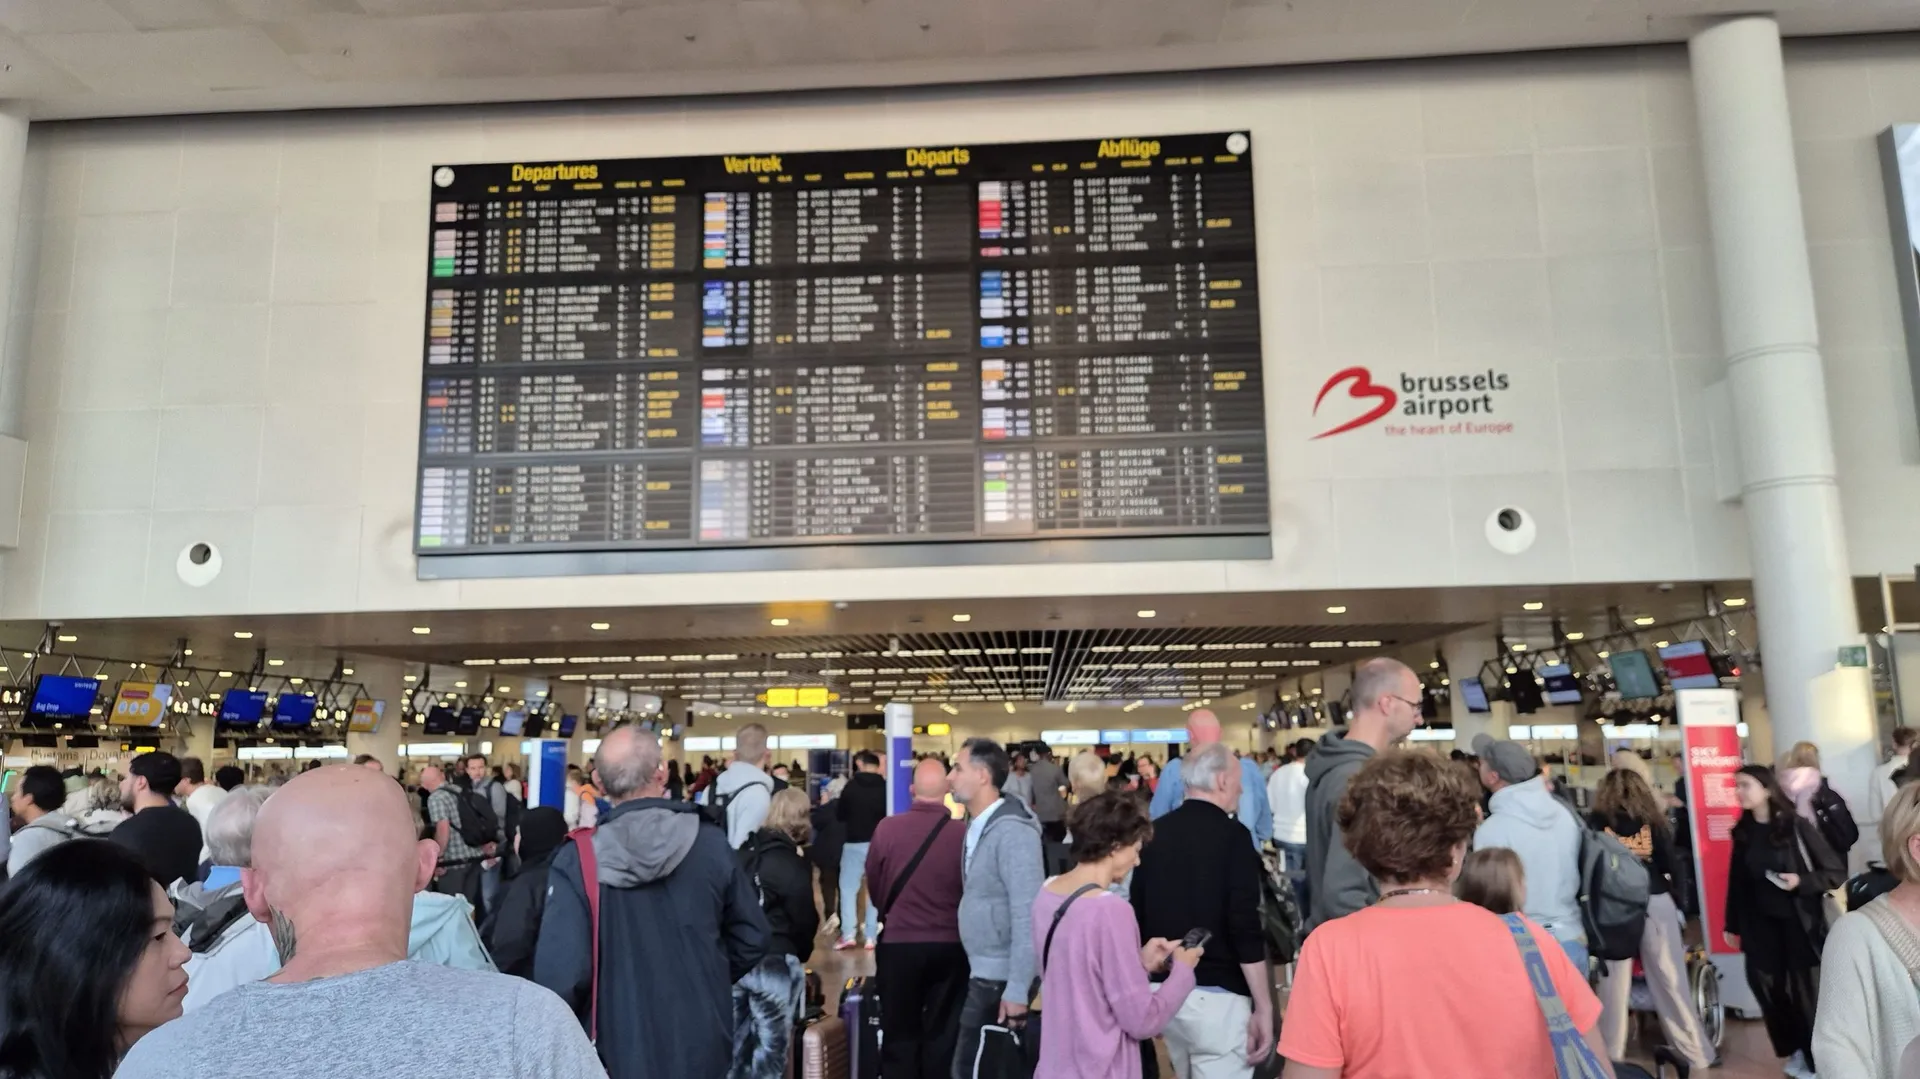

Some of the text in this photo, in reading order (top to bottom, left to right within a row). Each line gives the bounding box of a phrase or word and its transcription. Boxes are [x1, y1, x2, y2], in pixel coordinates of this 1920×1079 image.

[906, 147, 970, 169] Départs
[1098, 140, 1161, 159] Abflüge
[512, 164, 598, 183] Departures
[724, 154, 783, 174] Vertrek
[1401, 369, 1509, 393] brussels
[1403, 394, 1493, 419] airport
[1385, 421, 1514, 435] the heart of Europe
